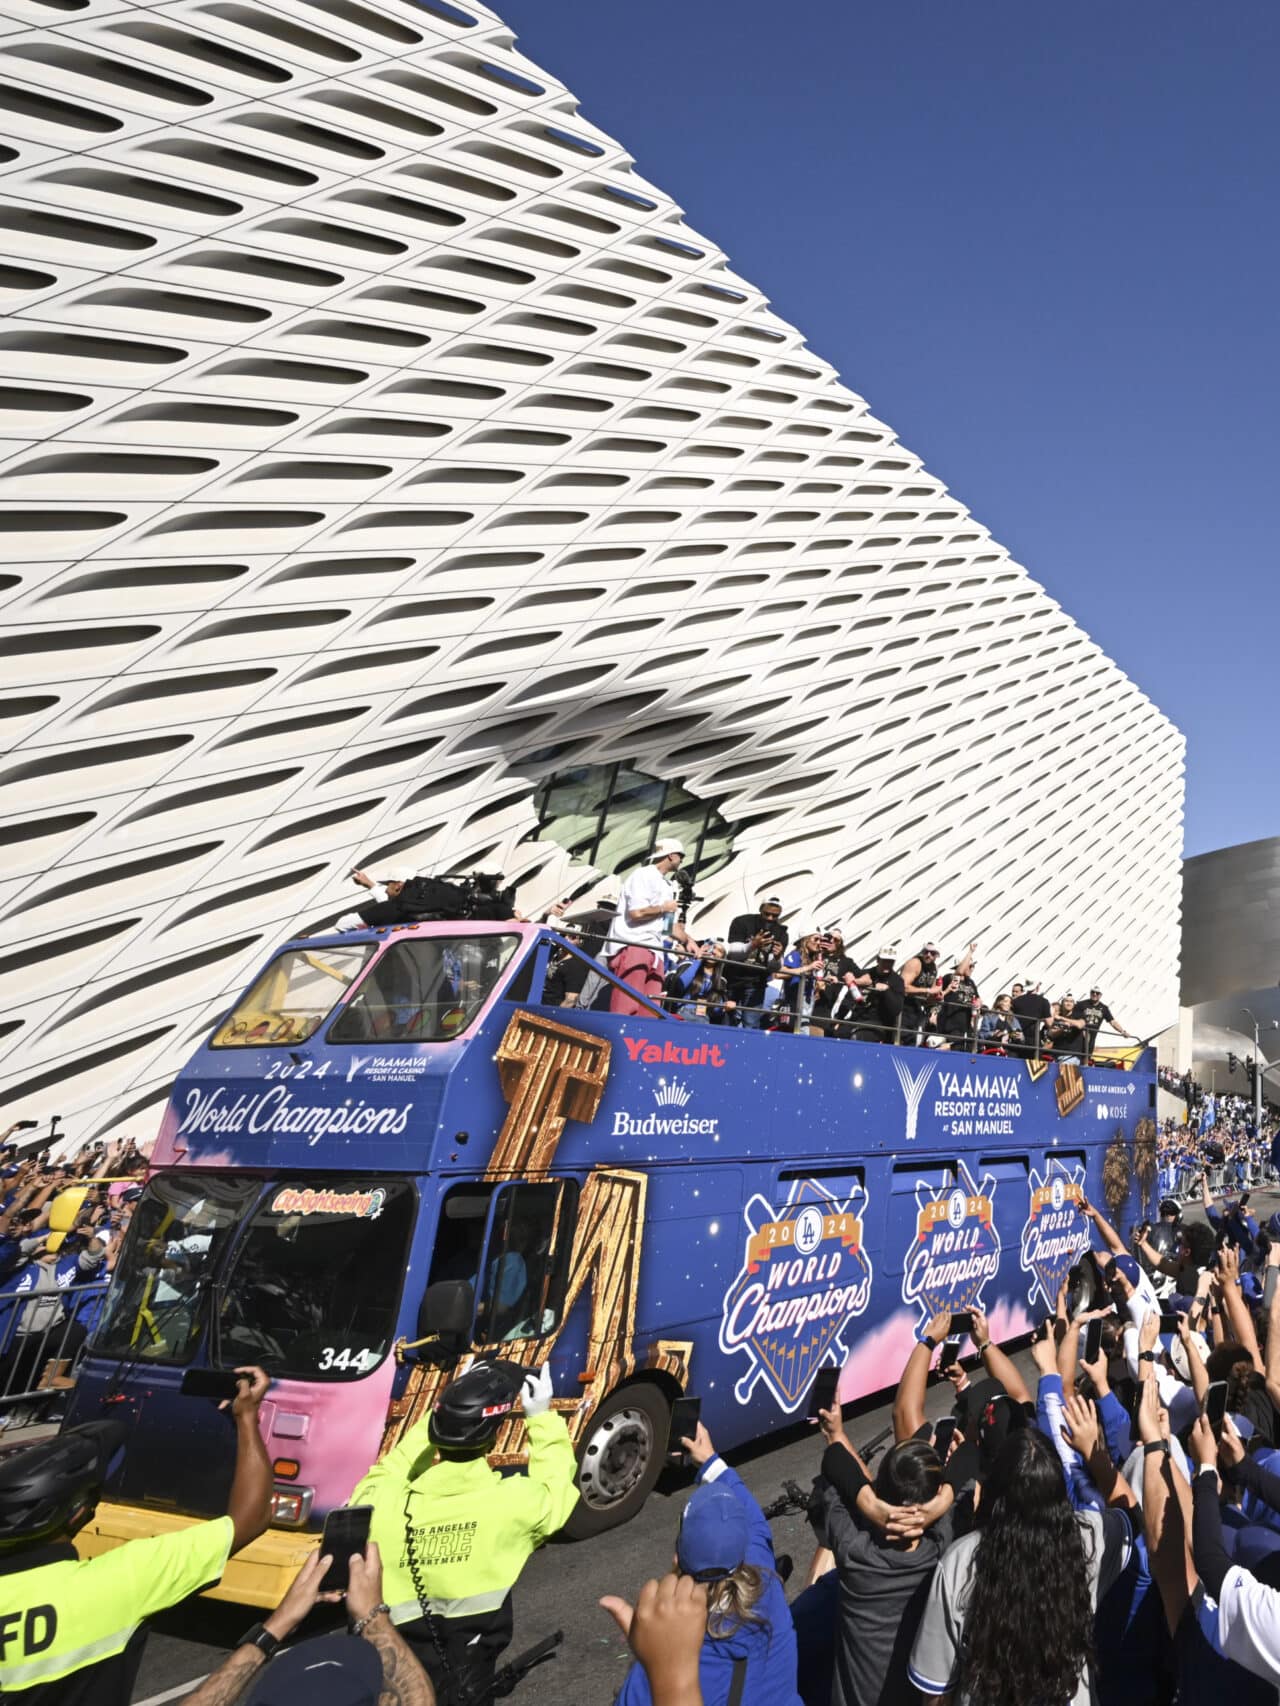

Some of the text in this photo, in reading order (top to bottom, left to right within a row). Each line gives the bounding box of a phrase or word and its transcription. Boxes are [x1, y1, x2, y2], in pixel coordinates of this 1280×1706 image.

[623, 1037, 726, 1068] Yakult
[264, 1060, 332, 1080] 2024
[177, 1085, 413, 1146] World Champions
[934, 1101, 1022, 1117] RESORT & CASINO
[611, 1112, 718, 1136] Budweiser
[951, 1120, 973, 1135] SAN
[975, 1120, 1014, 1135] MANUEL
[930, 1205, 945, 1219] 20
[969, 1200, 982, 1213] 24
[1040, 1209, 1075, 1233] WORLD
[768, 1216, 846, 1245] 20 LA 24
[931, 1227, 979, 1257] WORLD
[1024, 1227, 1089, 1265] Champions
[767, 1252, 842, 1291] WORLD
[906, 1248, 998, 1296] Champions
[726, 1277, 868, 1344] Champions
[318, 1347, 370, 1371] 344
[429, 1521, 477, 1534] ANGELES
[400, 1529, 476, 1561] FIRE
[399, 1555, 470, 1568] DARTMENT
[0, 1604, 58, 1662] FD
